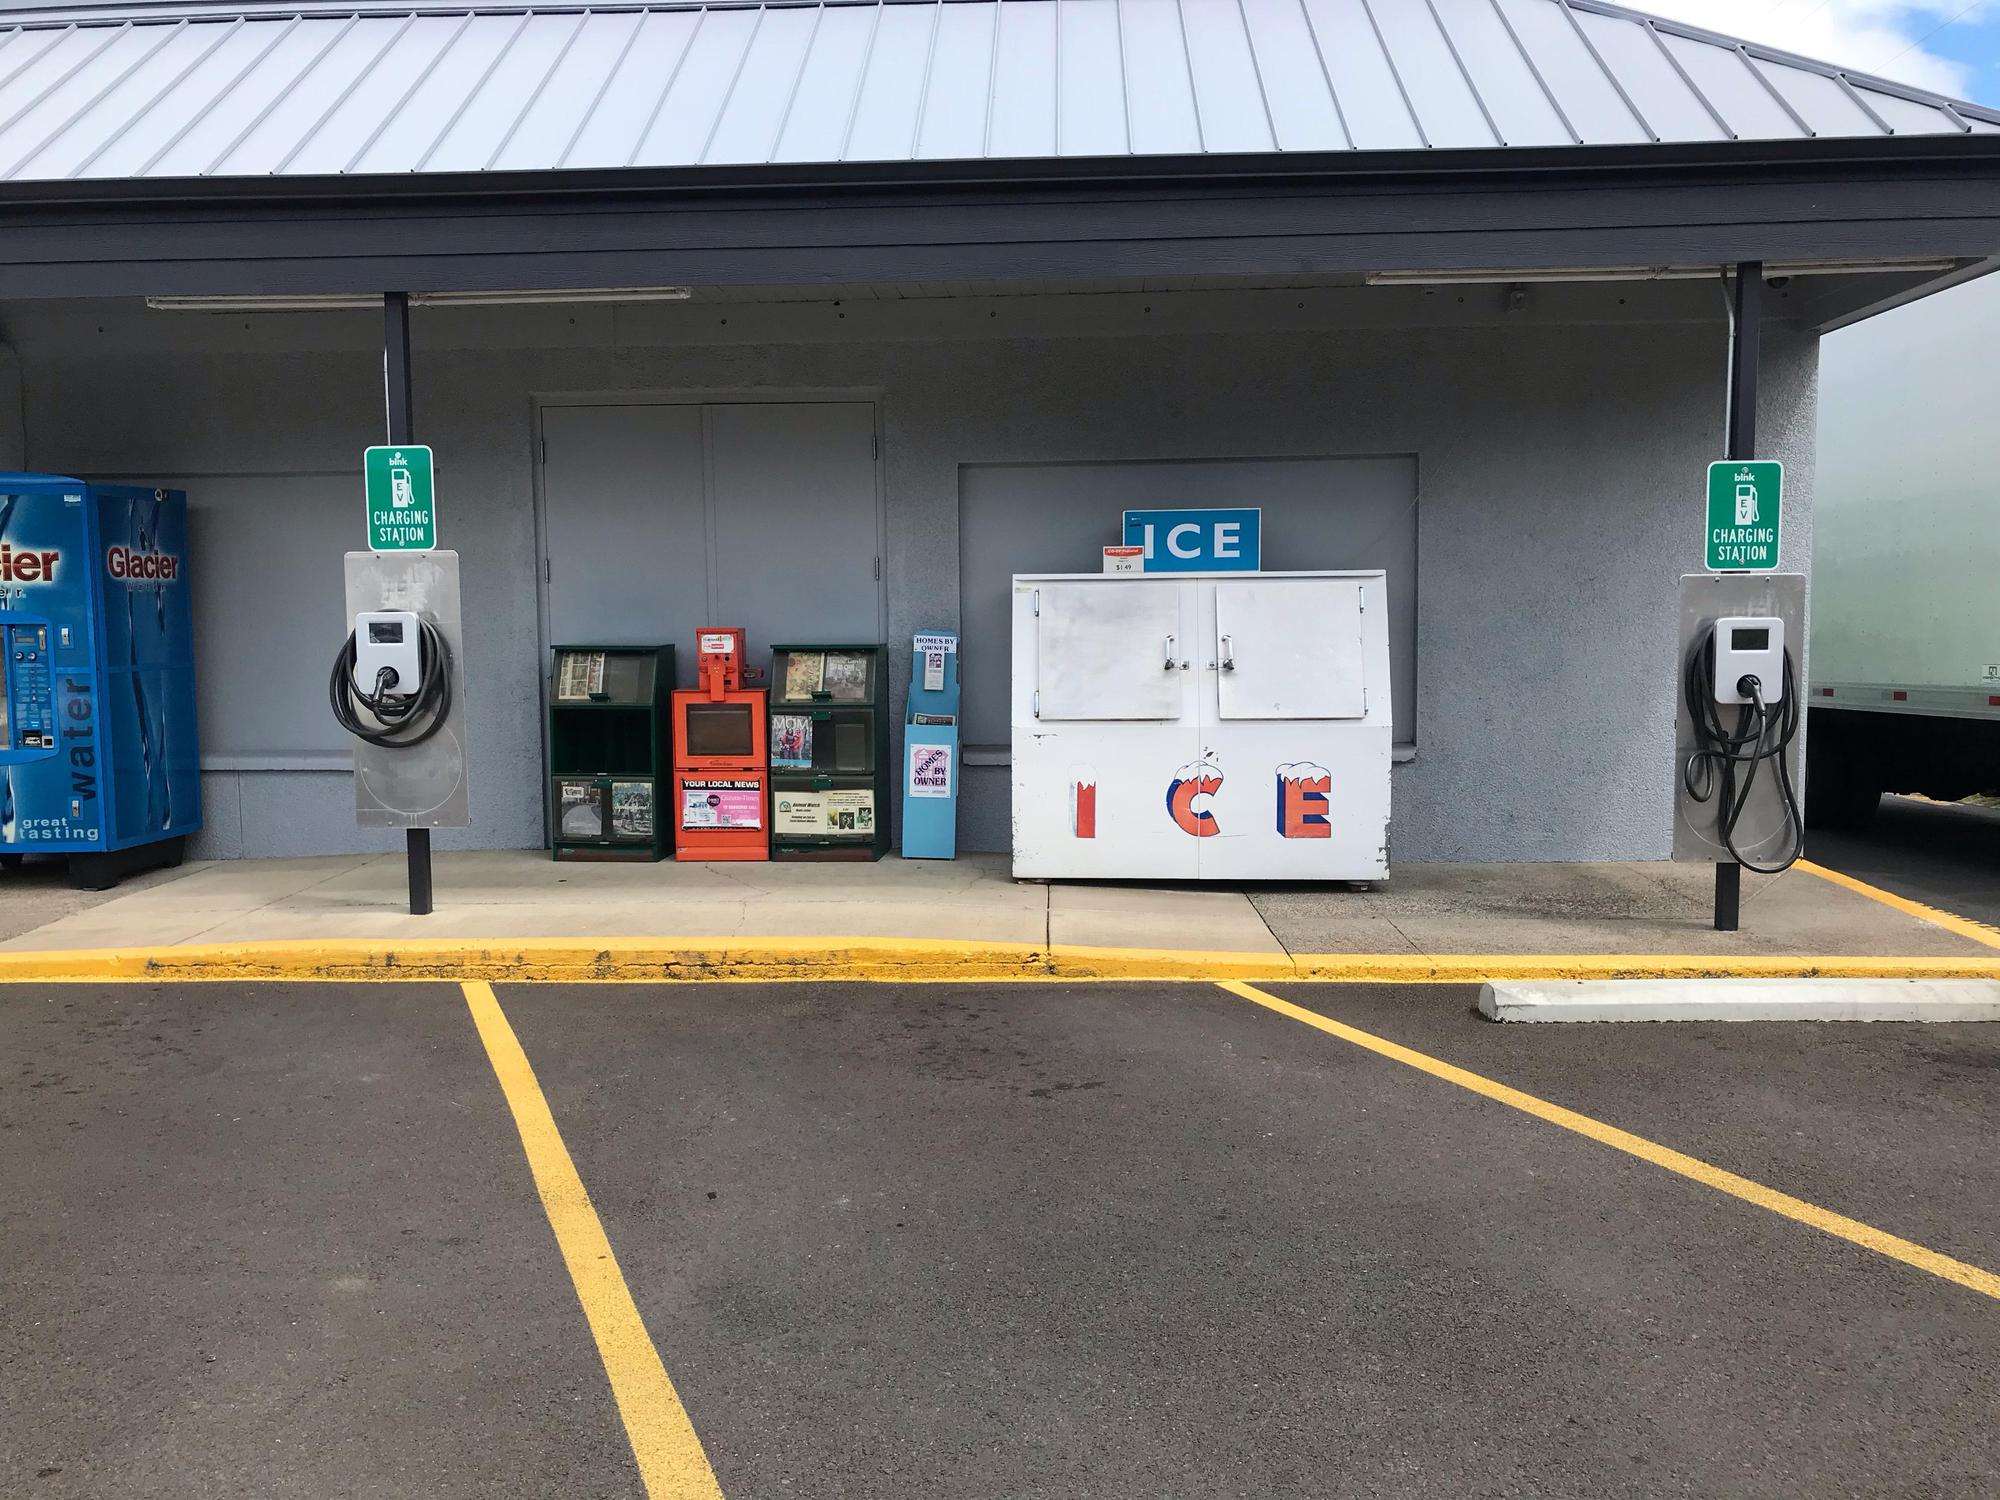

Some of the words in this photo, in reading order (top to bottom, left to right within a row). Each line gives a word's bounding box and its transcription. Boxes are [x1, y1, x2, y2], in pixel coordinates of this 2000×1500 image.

[389, 457, 408, 466] blink
[1734, 472, 1756, 482] blink
[374, 510, 429, 525] CHARGING
[380, 527, 424, 541] STATION
[1144, 523, 1240, 559] ICE
[1713, 528, 1774, 543] CHARGING
[1718, 545, 1767, 560] STATION
[0, 544, 59, 581] ier
[108, 547, 178, 579] Glacier
[773, 717, 809, 730] MOM
[63, 678, 97, 801] water
[915, 749, 943, 776] HOMES
[934, 767, 946, 775] BY
[684, 780, 706, 788] YOUR
[707, 780, 732, 788] LOCAL
[914, 777, 947, 786] OWNER
[22, 817, 68, 829] great
[19, 827, 99, 841] tasting
